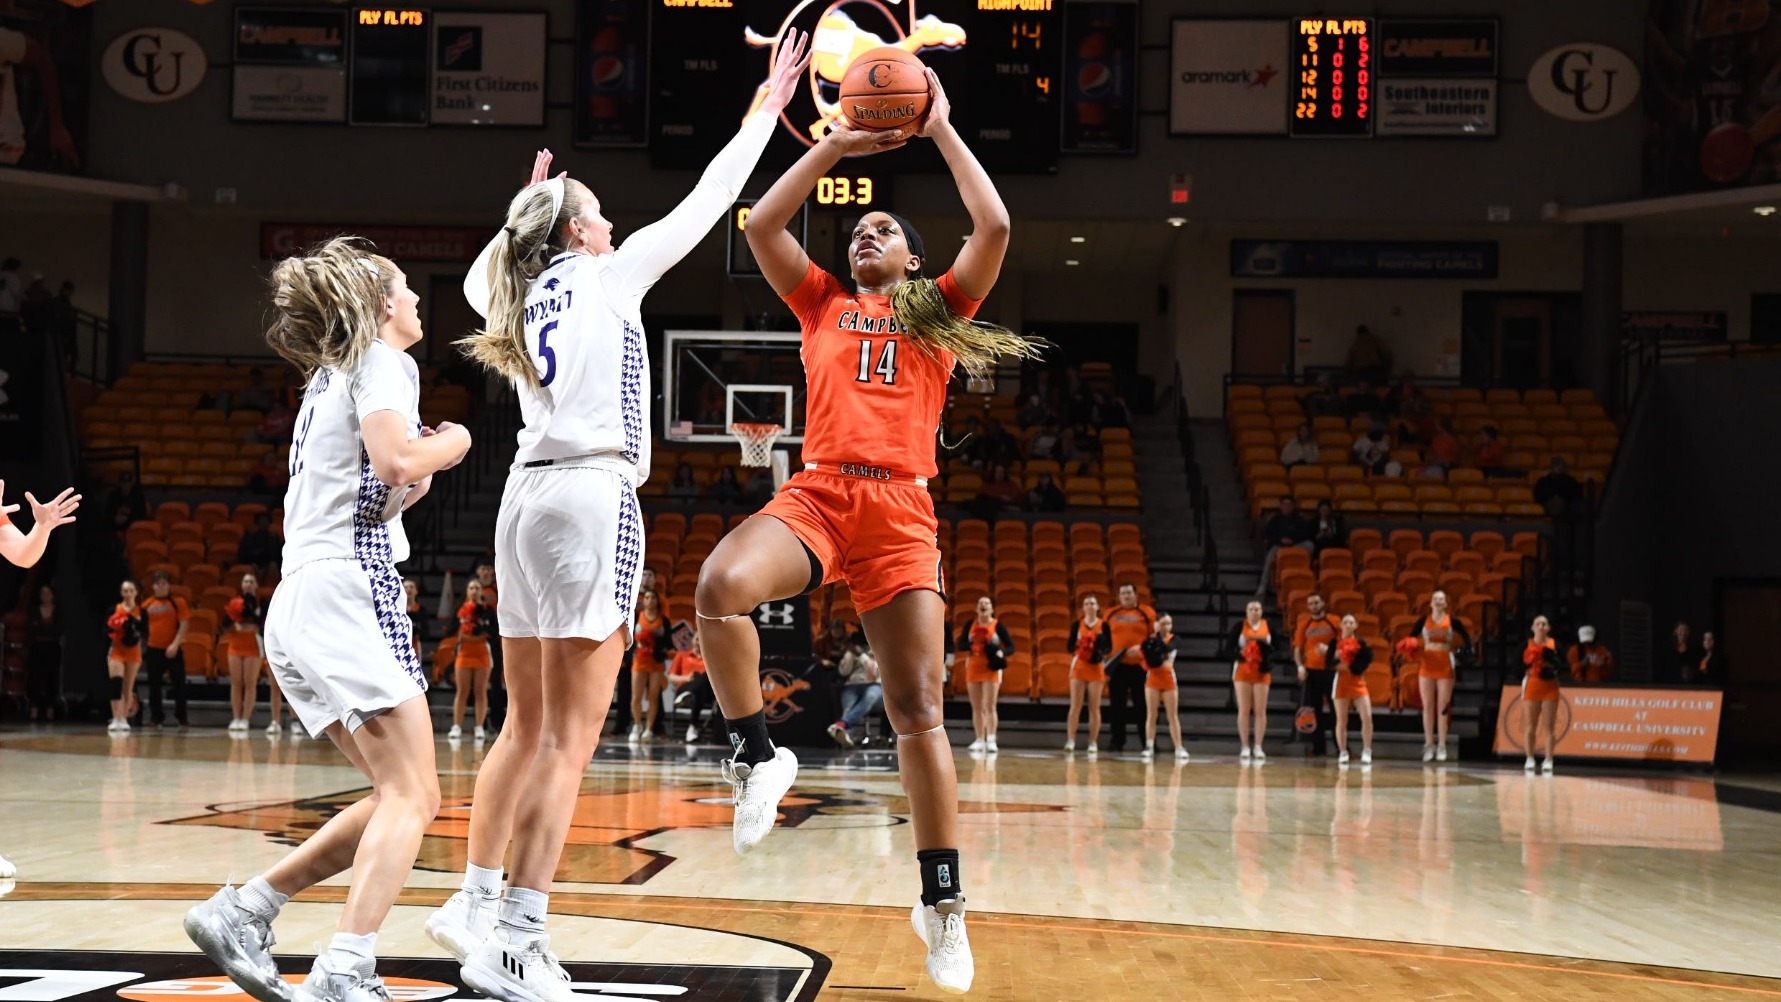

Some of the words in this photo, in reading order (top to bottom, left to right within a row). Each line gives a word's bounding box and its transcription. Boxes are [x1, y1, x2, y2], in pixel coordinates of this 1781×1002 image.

[359, 10, 381, 25] PLY
[384, 10, 399, 25] FL
[400, 11, 423, 26] PTS
[1011, 21, 1041, 50] 14
[1300, 20, 1323, 35] PLY
[1325, 20, 1341, 35] FL
[1342, 20, 1367, 35] PTS
[1307, 36, 1318, 53] 5
[1338, 37, 1344, 51] 1
[123, 34, 185, 95] CU
[1302, 53, 1318, 67] 11
[1332, 51, 1344, 68] 0
[1358, 52, 1369, 68] 2
[436, 76, 469, 91] First
[476, 75, 539, 92] Citizens
[868, 64, 892, 88] C
[1182, 69, 1250, 83] aramark
[1301, 69, 1318, 85] 12
[1332, 69, 1343, 85] 0
[1358, 69, 1370, 85] 0
[1551, 49, 1617, 114] CU
[1036, 76, 1050, 94] 4
[1301, 86, 1317, 100] 14
[1331, 86, 1343, 101] 0
[1357, 86, 1369, 101] 0
[1385, 86, 1490, 100] Southeastern
[436, 96, 475, 109] Bank
[853, 102, 914, 119] SPALDING
[1296, 102, 1317, 119] 22
[1331, 102, 1342, 119] 0
[1357, 102, 1368, 119] 2
[1426, 103, 1485, 114] Interiors
[817, 177, 872, 205] 03.3
[539, 319, 559, 388] 5
[855, 339, 898, 385] 14
[840, 463, 892, 481] CAMELS
[1575, 696, 1609, 708] KEITH
[1612, 697, 1646, 709] HILLS
[1648, 699, 1679, 710] GOLF
[1682, 700, 1714, 711] CLUB
[1635, 712, 1648, 721] AT
[1573, 722, 1632, 734] CAMPBELL
[1637, 724, 1706, 736] UNIVERSITY
